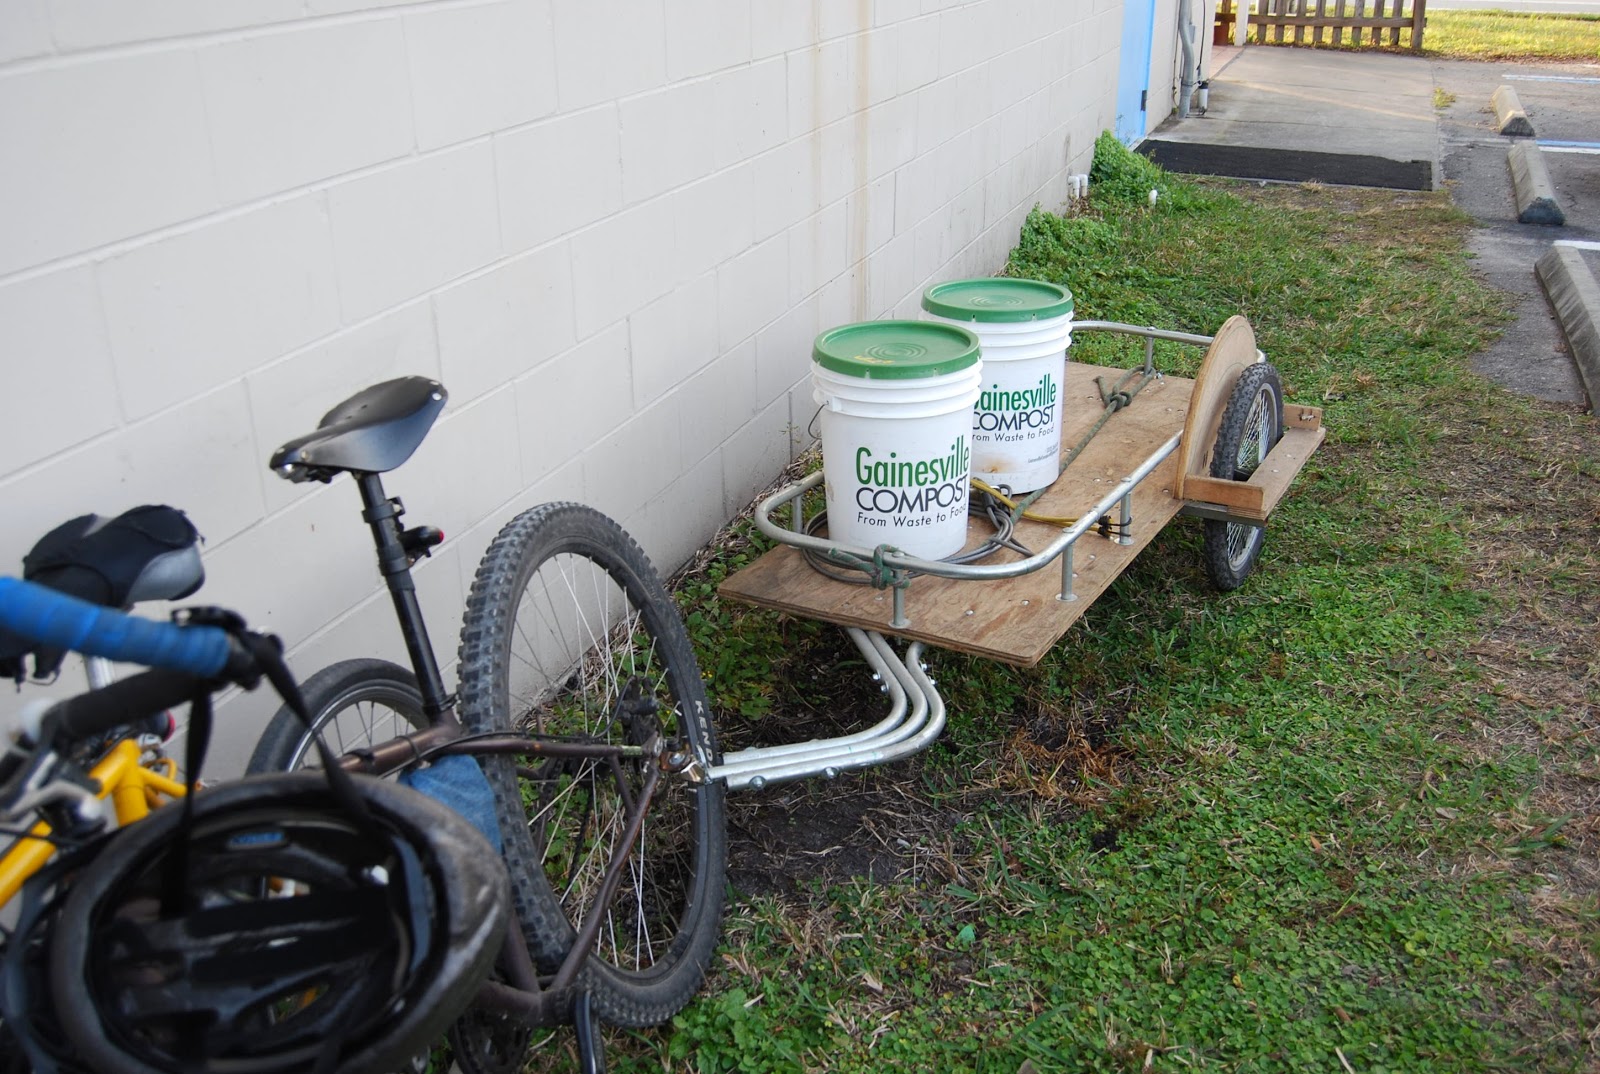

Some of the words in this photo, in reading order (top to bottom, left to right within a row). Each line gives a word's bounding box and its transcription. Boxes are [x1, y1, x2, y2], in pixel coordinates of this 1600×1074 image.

[974, 373, 1056, 411] ainesville
[972, 433, 990, 442] rom
[994, 432, 1024, 442] Waste
[1027, 431, 1036, 440] to
[1038, 422, 1055, 438] Food
[856, 435, 969, 487] Gainesville
[856, 474, 967, 514] COMPOST
[857, 511, 887, 527] From
[893, 515, 932, 527] Waste
[936, 512, 946, 523] to
